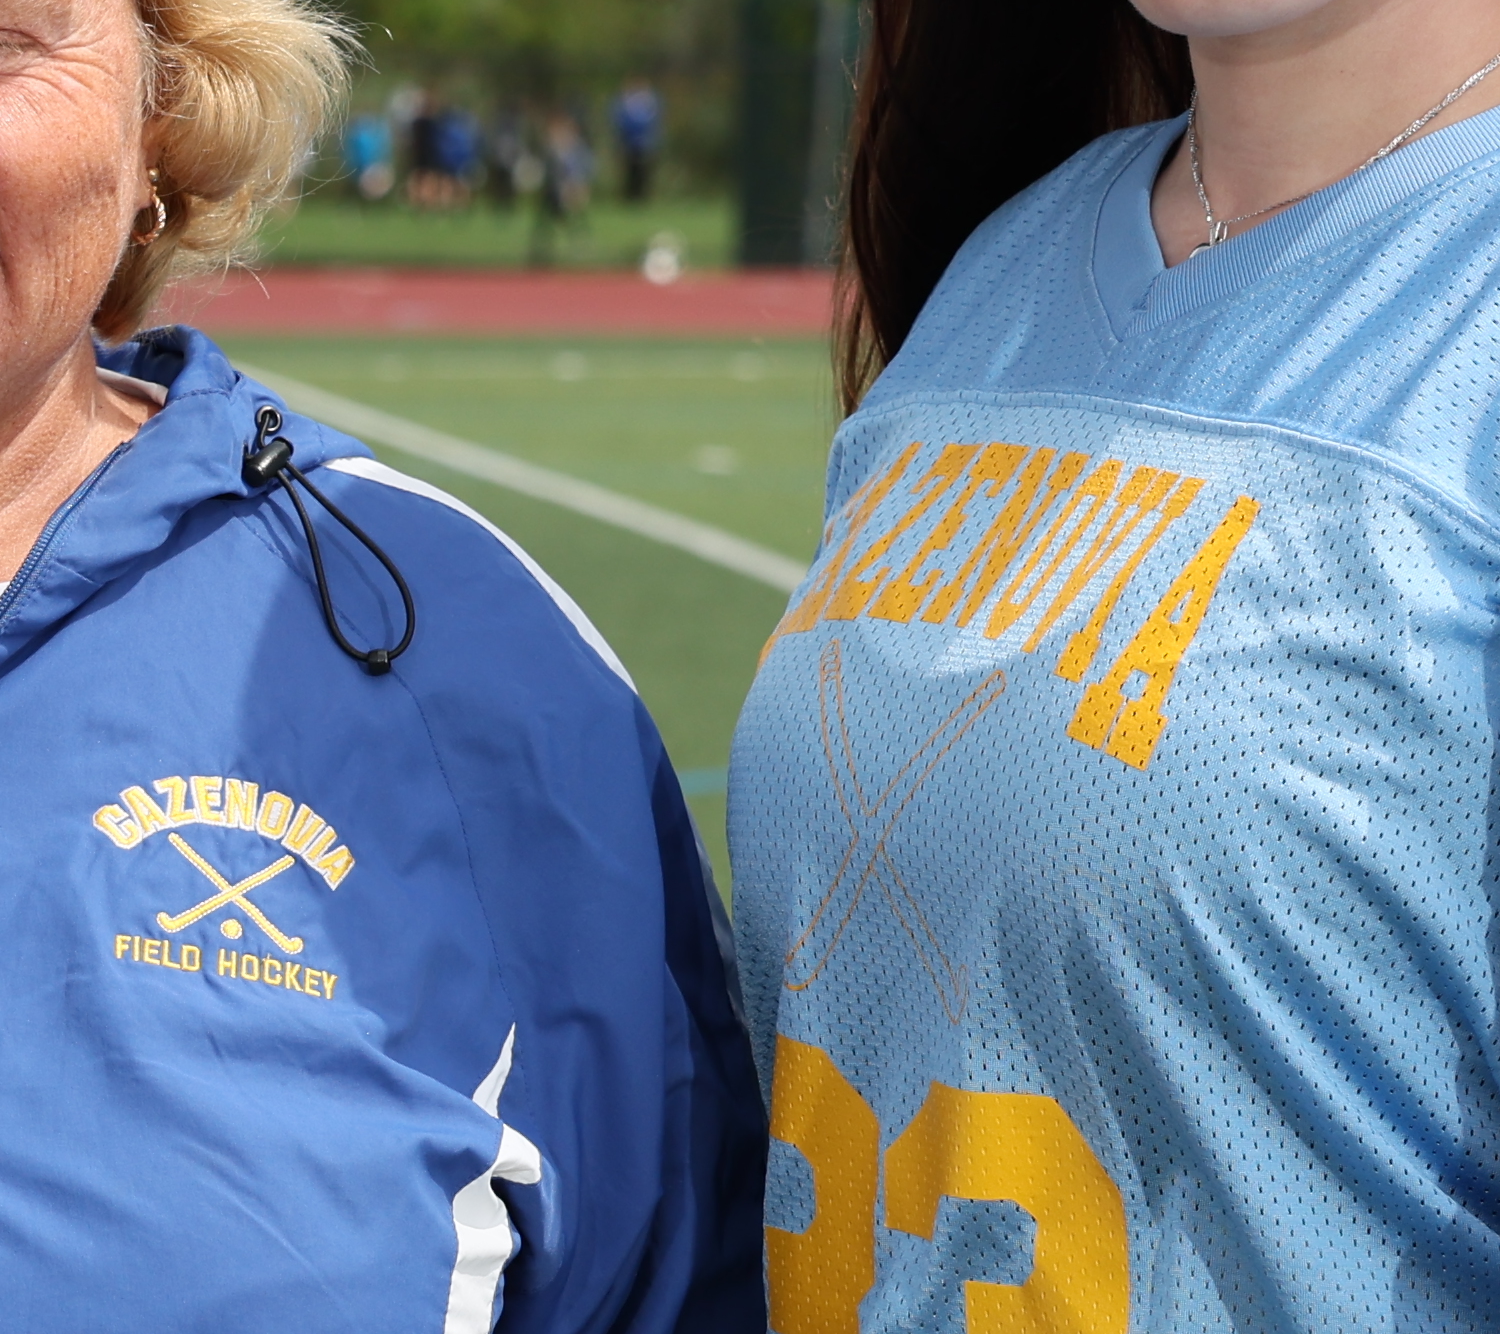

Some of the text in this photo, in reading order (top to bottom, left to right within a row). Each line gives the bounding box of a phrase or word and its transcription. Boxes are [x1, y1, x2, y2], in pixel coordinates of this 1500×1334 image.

[756, 441, 1262, 771] AZENOVIA
[93, 776, 355, 891] CAZENOVIA
[114, 935, 338, 1000] FIELD HOCKEY
